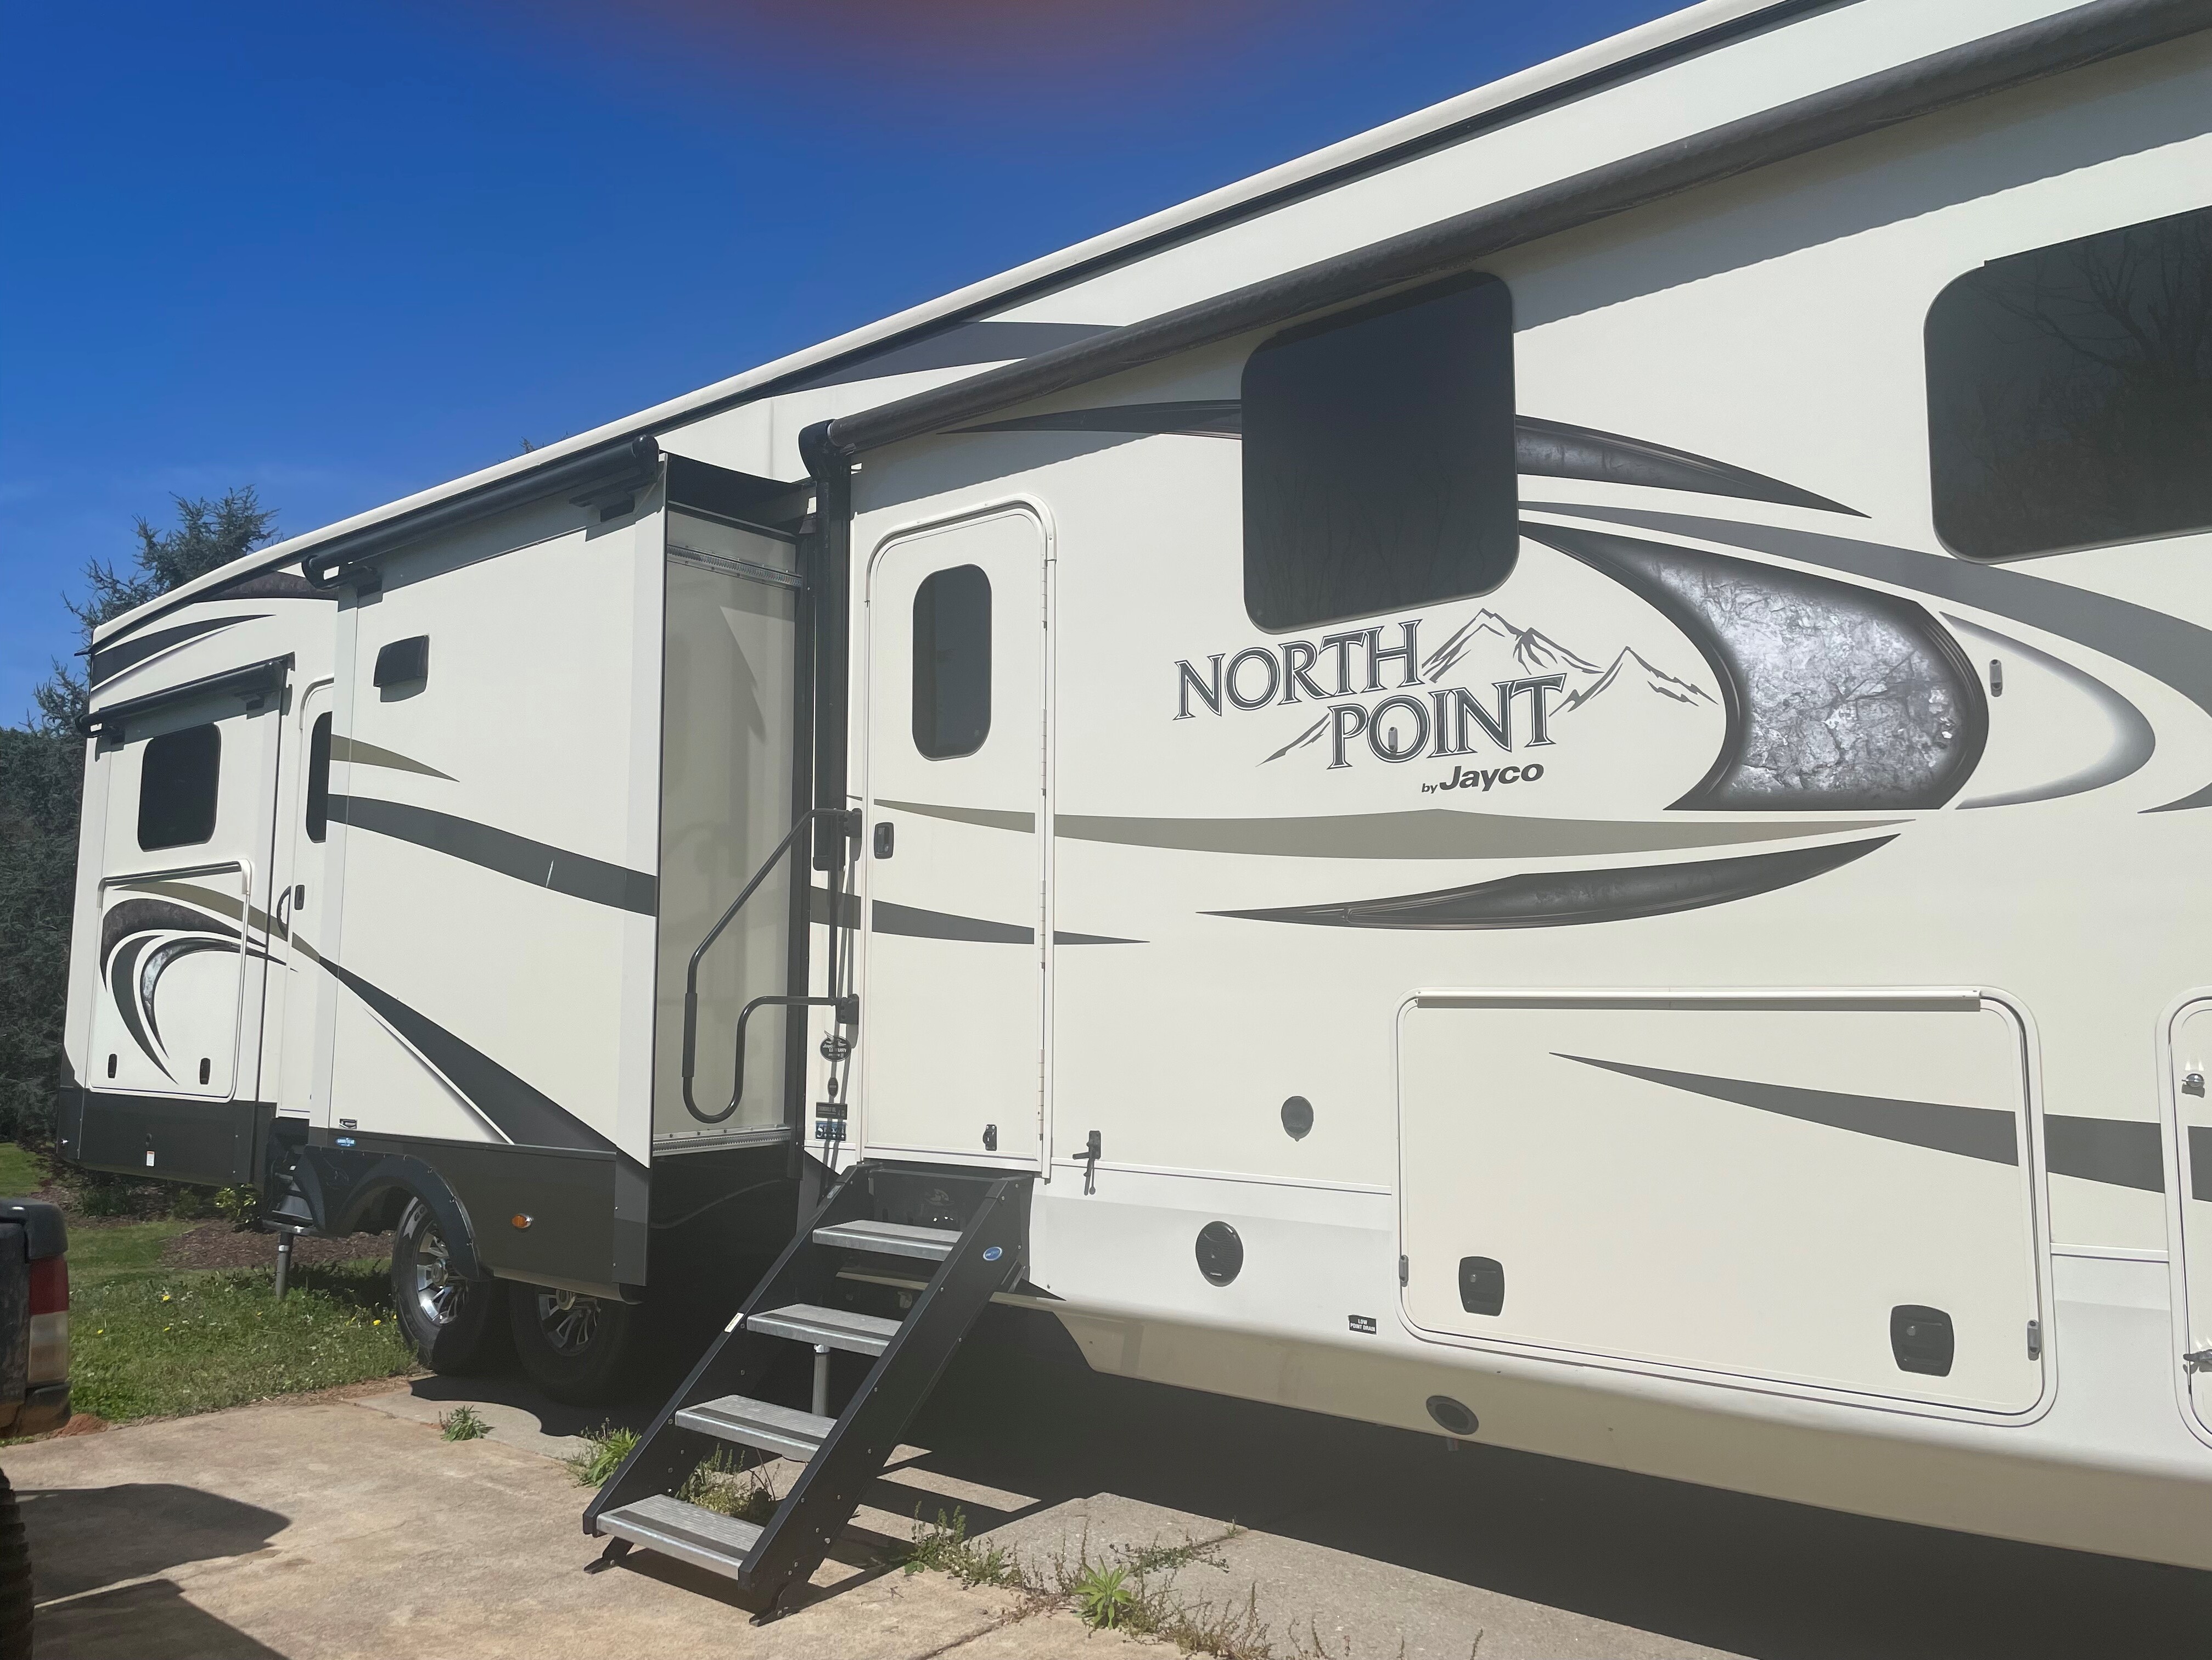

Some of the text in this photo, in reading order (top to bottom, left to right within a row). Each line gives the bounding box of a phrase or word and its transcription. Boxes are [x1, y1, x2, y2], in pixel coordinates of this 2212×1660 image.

[1172, 619, 1425, 720] NORTH
[1327, 673, 1567, 770] POINT
[1422, 764, 1544, 794] by Jayco
